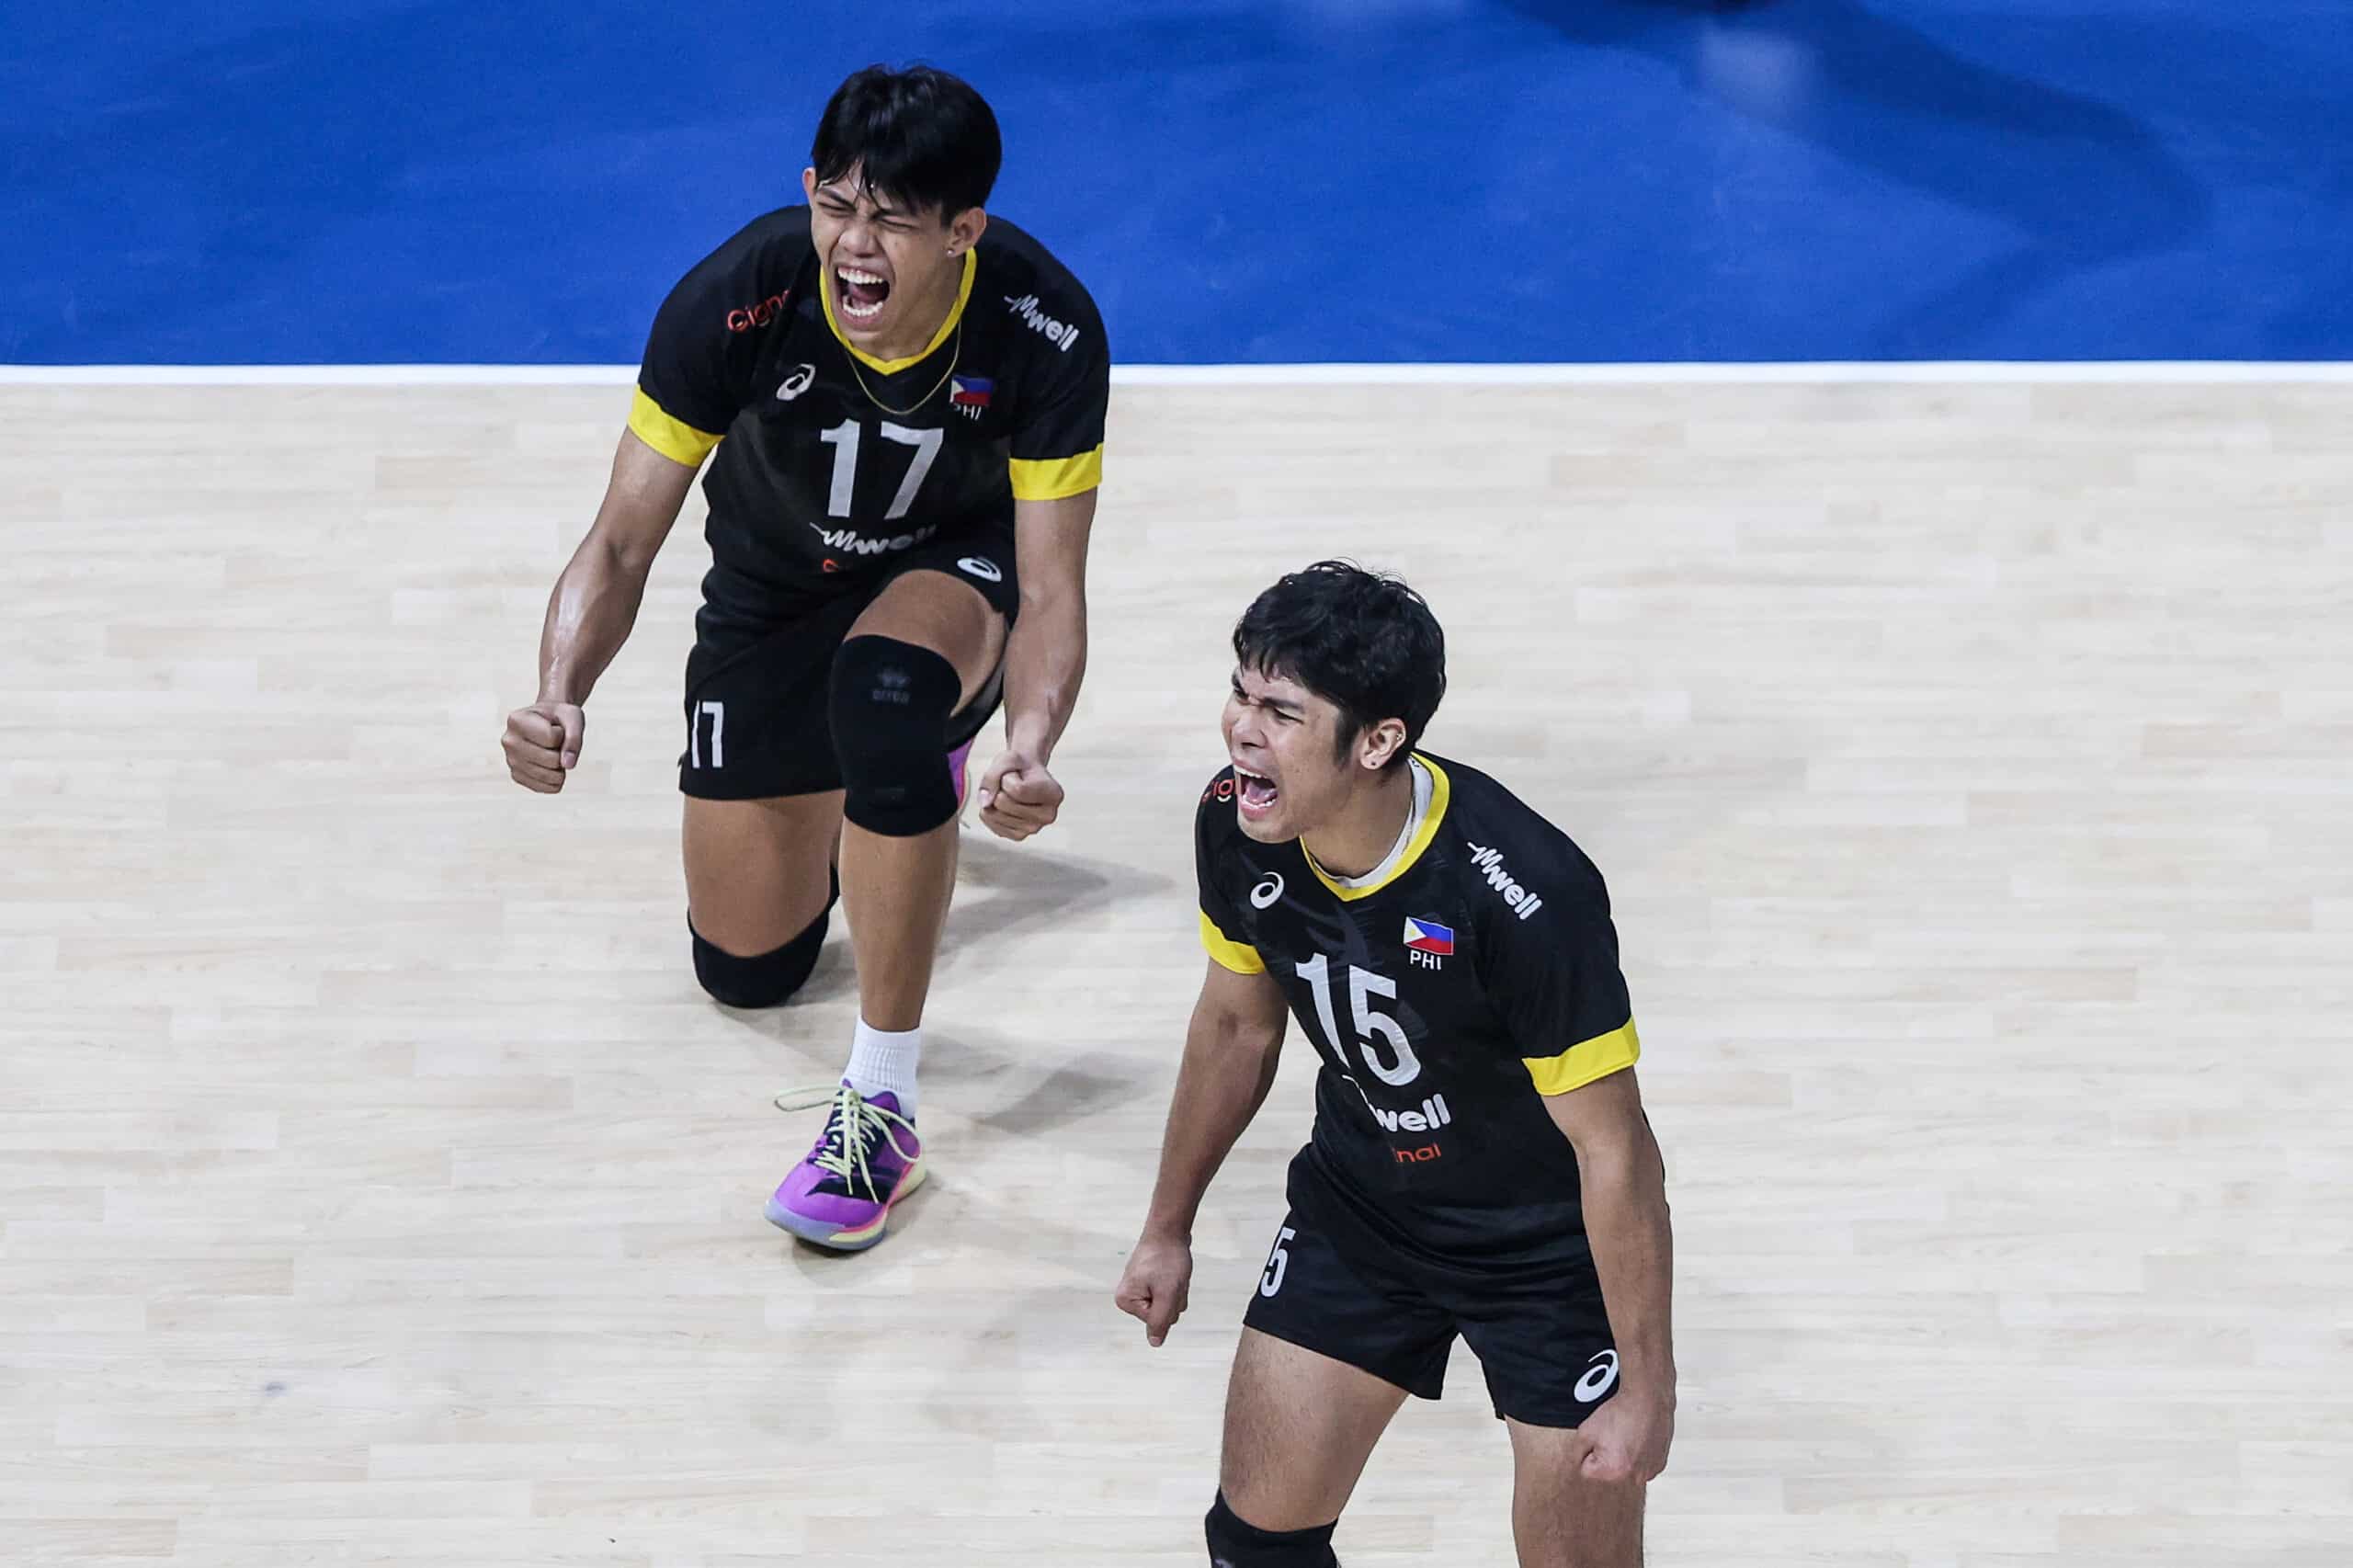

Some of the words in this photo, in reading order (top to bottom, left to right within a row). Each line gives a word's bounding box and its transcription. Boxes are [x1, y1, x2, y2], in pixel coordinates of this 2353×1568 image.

[821, 418, 944, 520] 17
[691, 699, 724, 768] 17
[1409, 949, 1442, 971] PHI
[1295, 952, 1421, 1086] 15
[1260, 1226, 1297, 1298] 5
